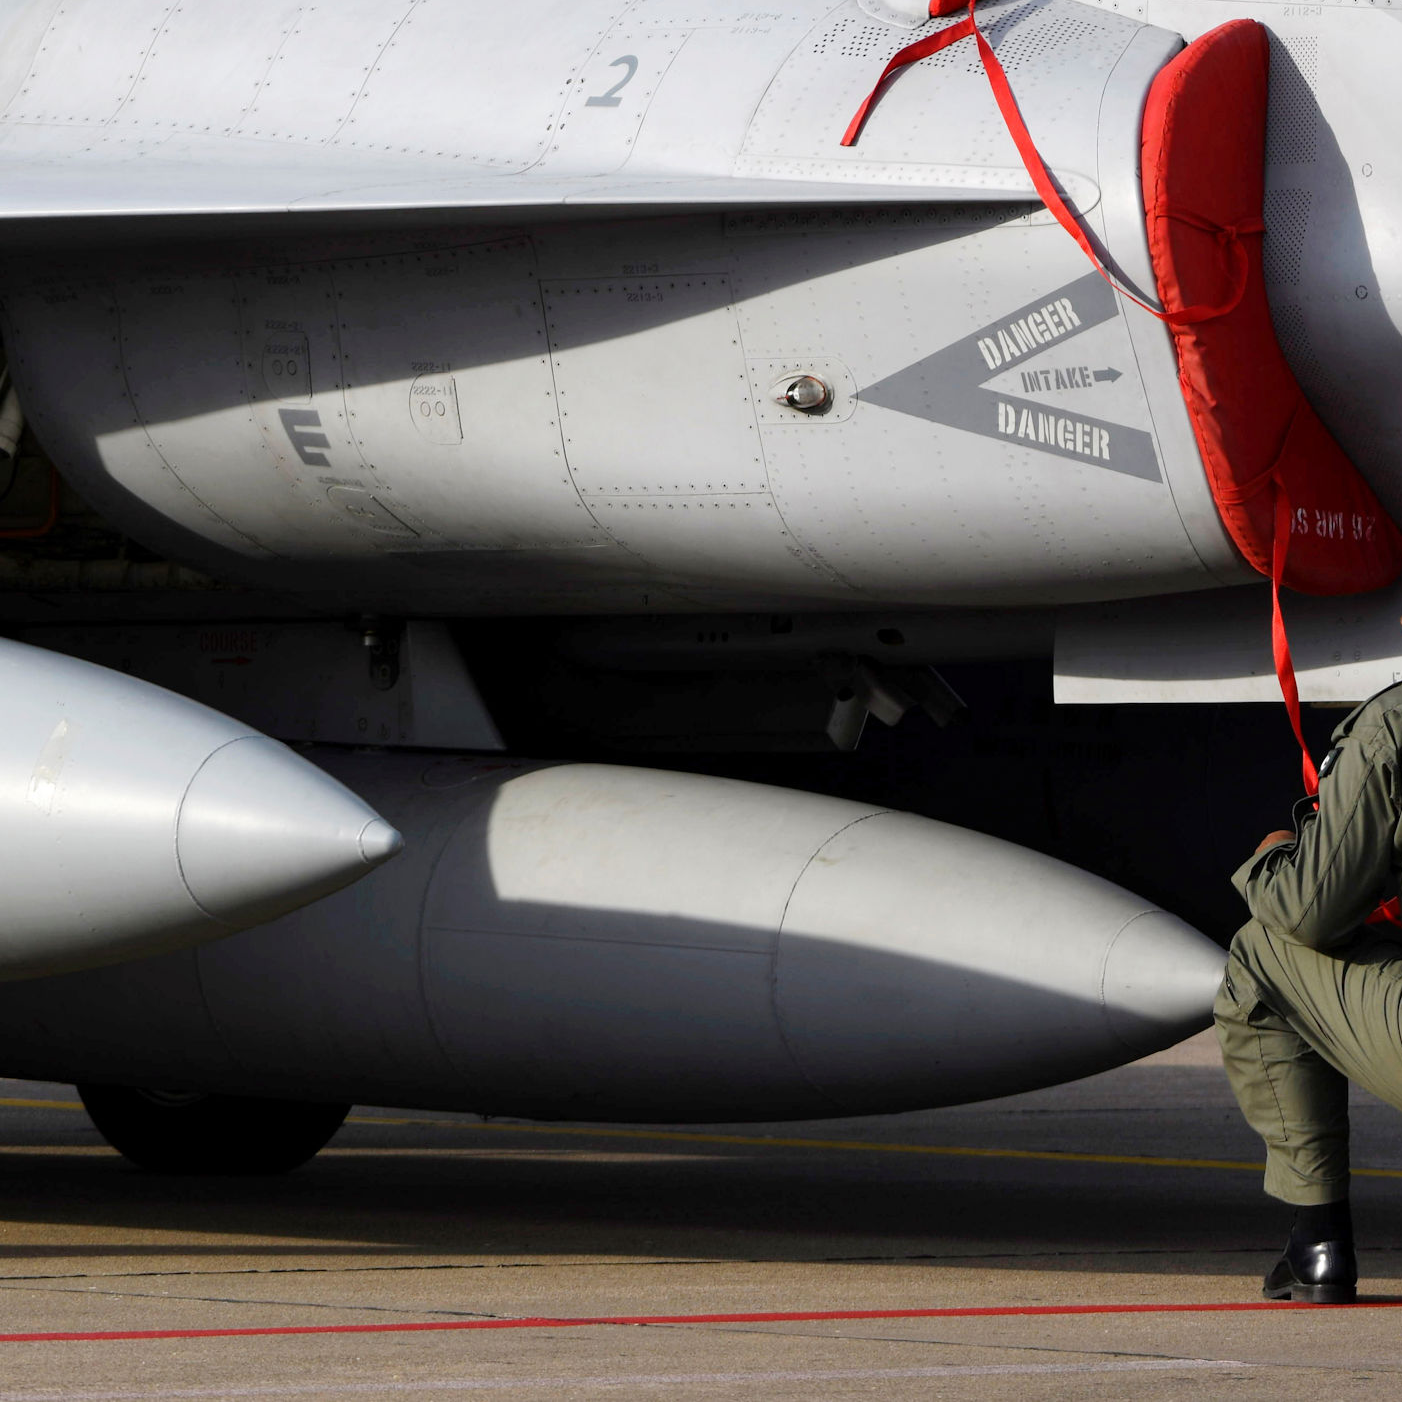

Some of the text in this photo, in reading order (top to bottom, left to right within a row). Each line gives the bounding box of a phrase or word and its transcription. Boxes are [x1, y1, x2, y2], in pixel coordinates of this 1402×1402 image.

[1283, 6, 1322, 17] 2112-3
[584, 54, 639, 108] 2
[977, 297, 1082, 370] DANGER
[413, 385, 453, 396] 2222-11
[1021, 366, 1093, 393] INTAKE
[998, 401, 1110, 460] DANGER
